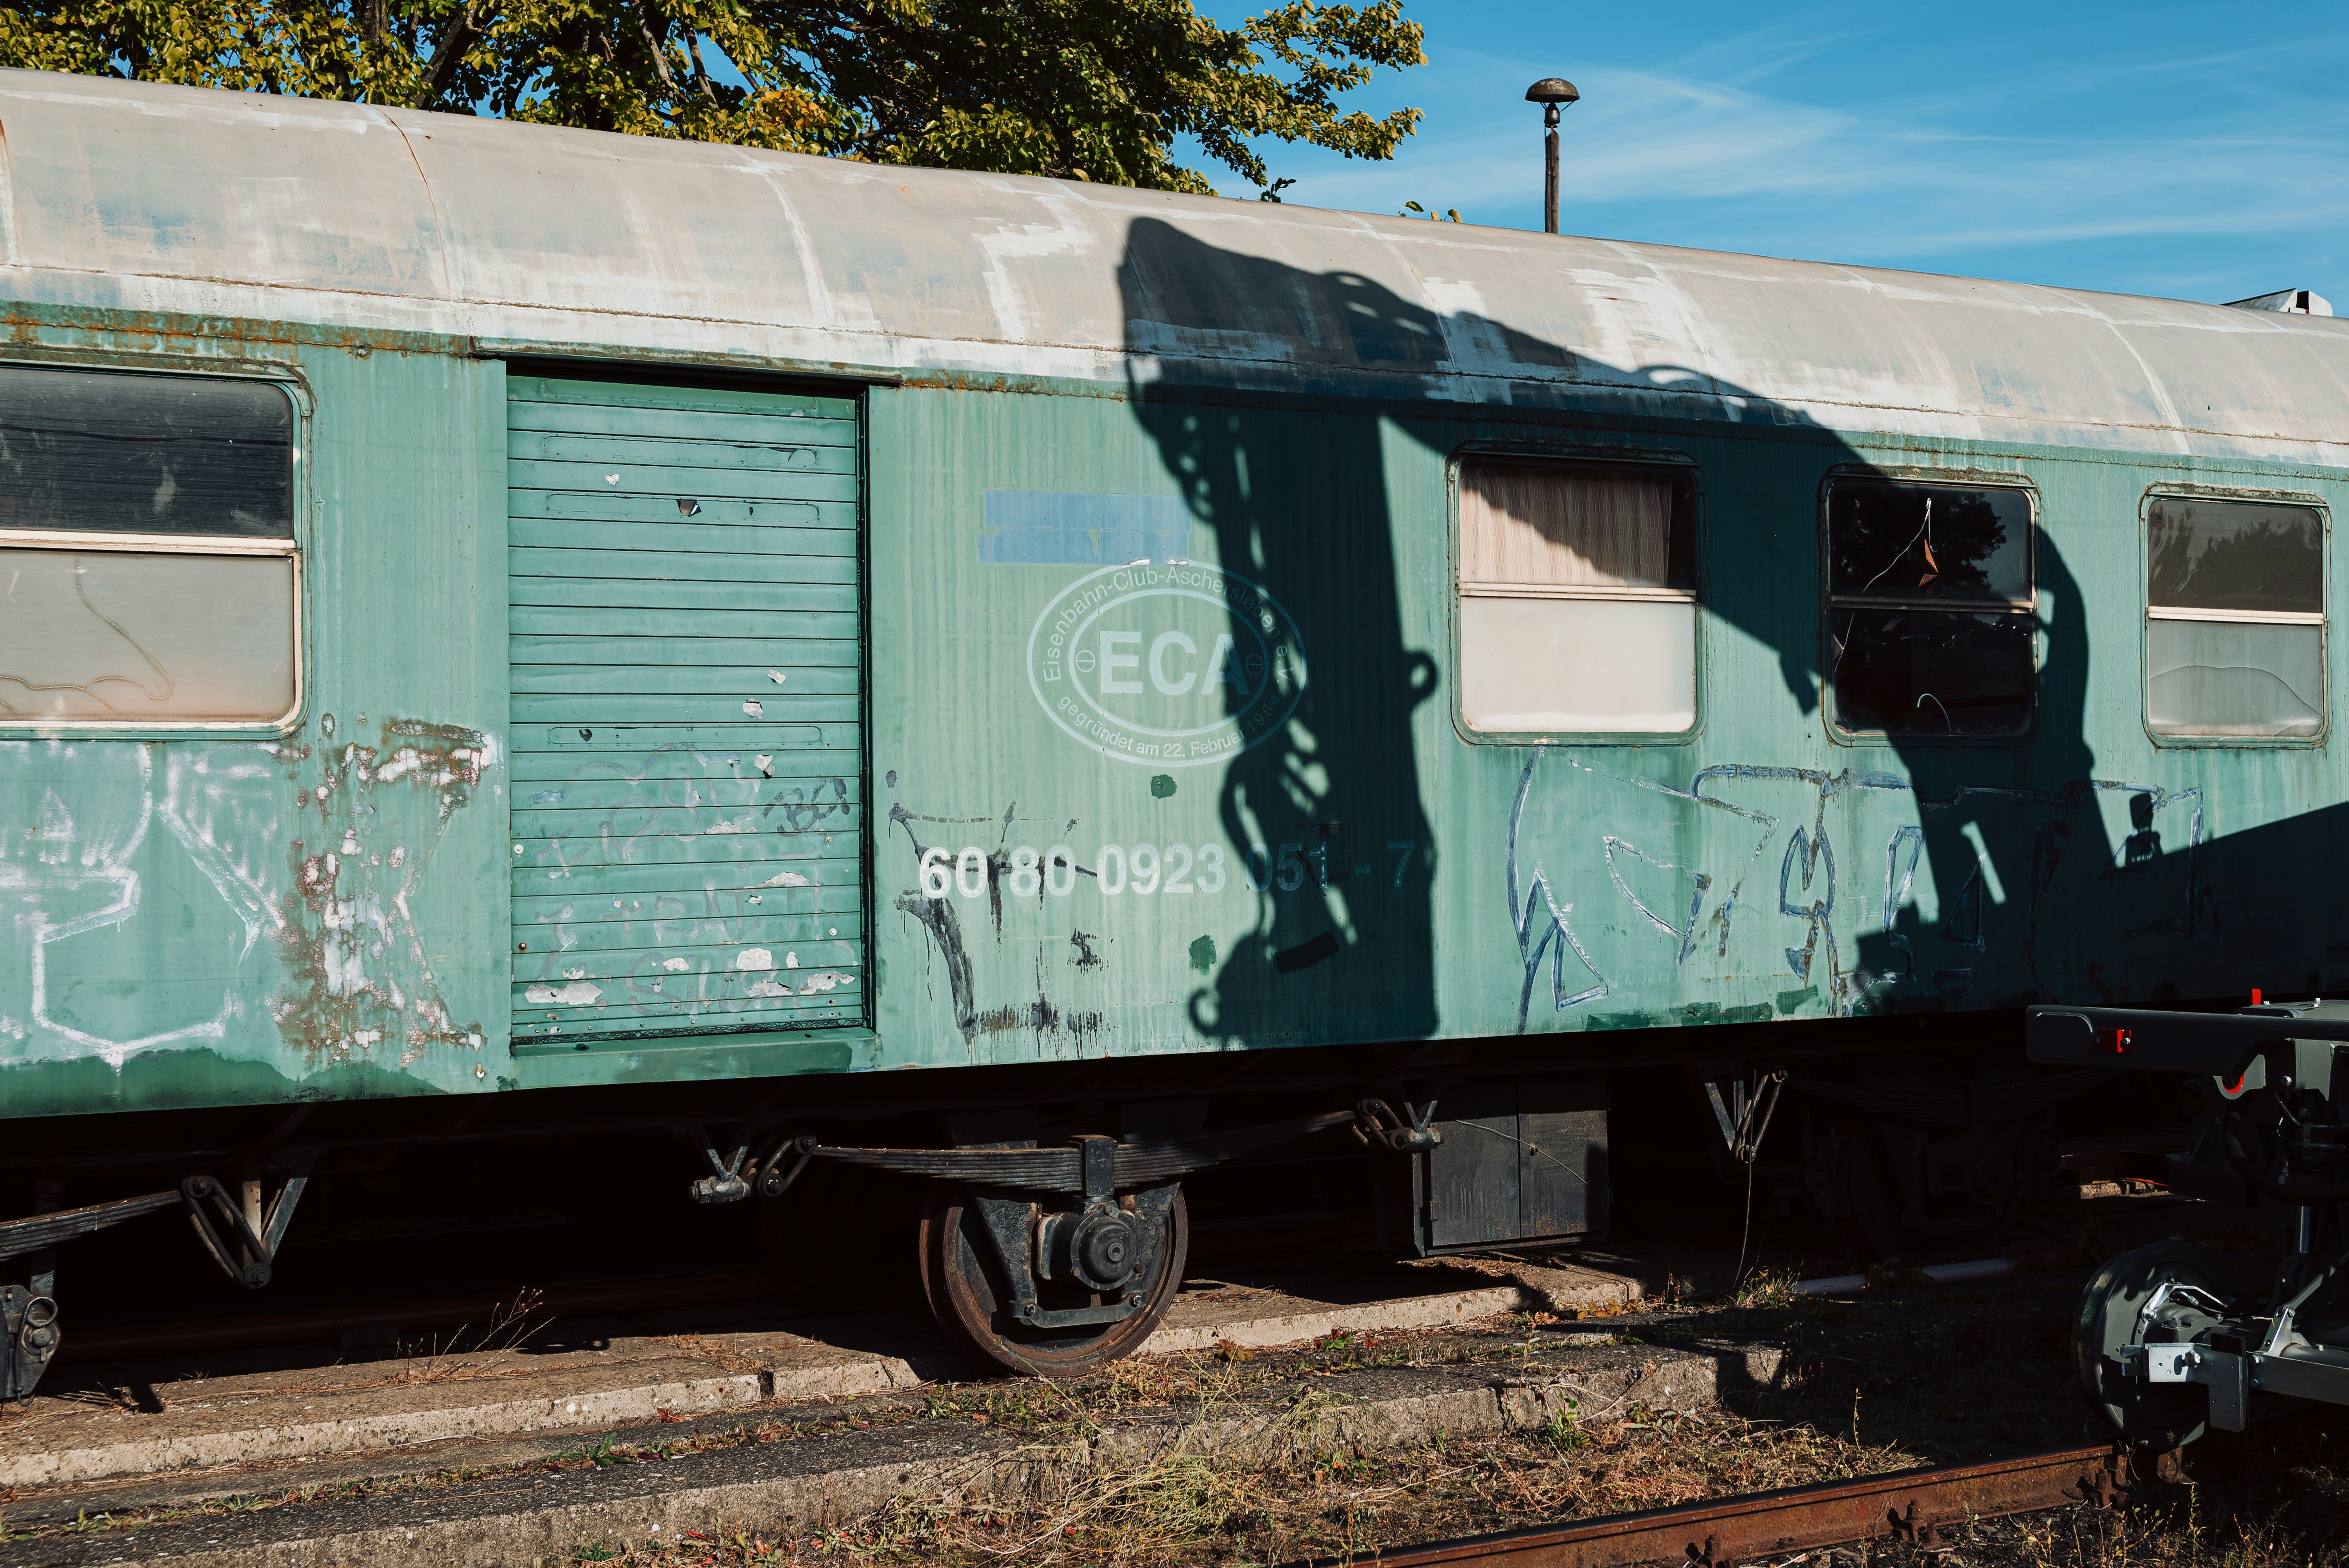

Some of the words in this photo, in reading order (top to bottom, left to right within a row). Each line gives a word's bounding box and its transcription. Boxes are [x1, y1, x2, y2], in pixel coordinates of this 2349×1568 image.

[1043, 566, 1281, 682] Eisenbahn-Club-Aschersleben
[1099, 631, 1250, 695] ECA
[1057, 695, 1134, 751] gegründet
[1136, 741, 1159, 757] am
[1163, 743, 1186, 757] 22.
[1190, 730, 1245, 756] Februar
[1247, 694, 1281, 733] 1964
[919, 846, 987, 898] 60
[1009, 845, 1076, 897] 80
[1097, 843, 1226, 895] 0923
[1245, 841, 1328, 892] 051
[1387, 841, 1416, 887] 7
